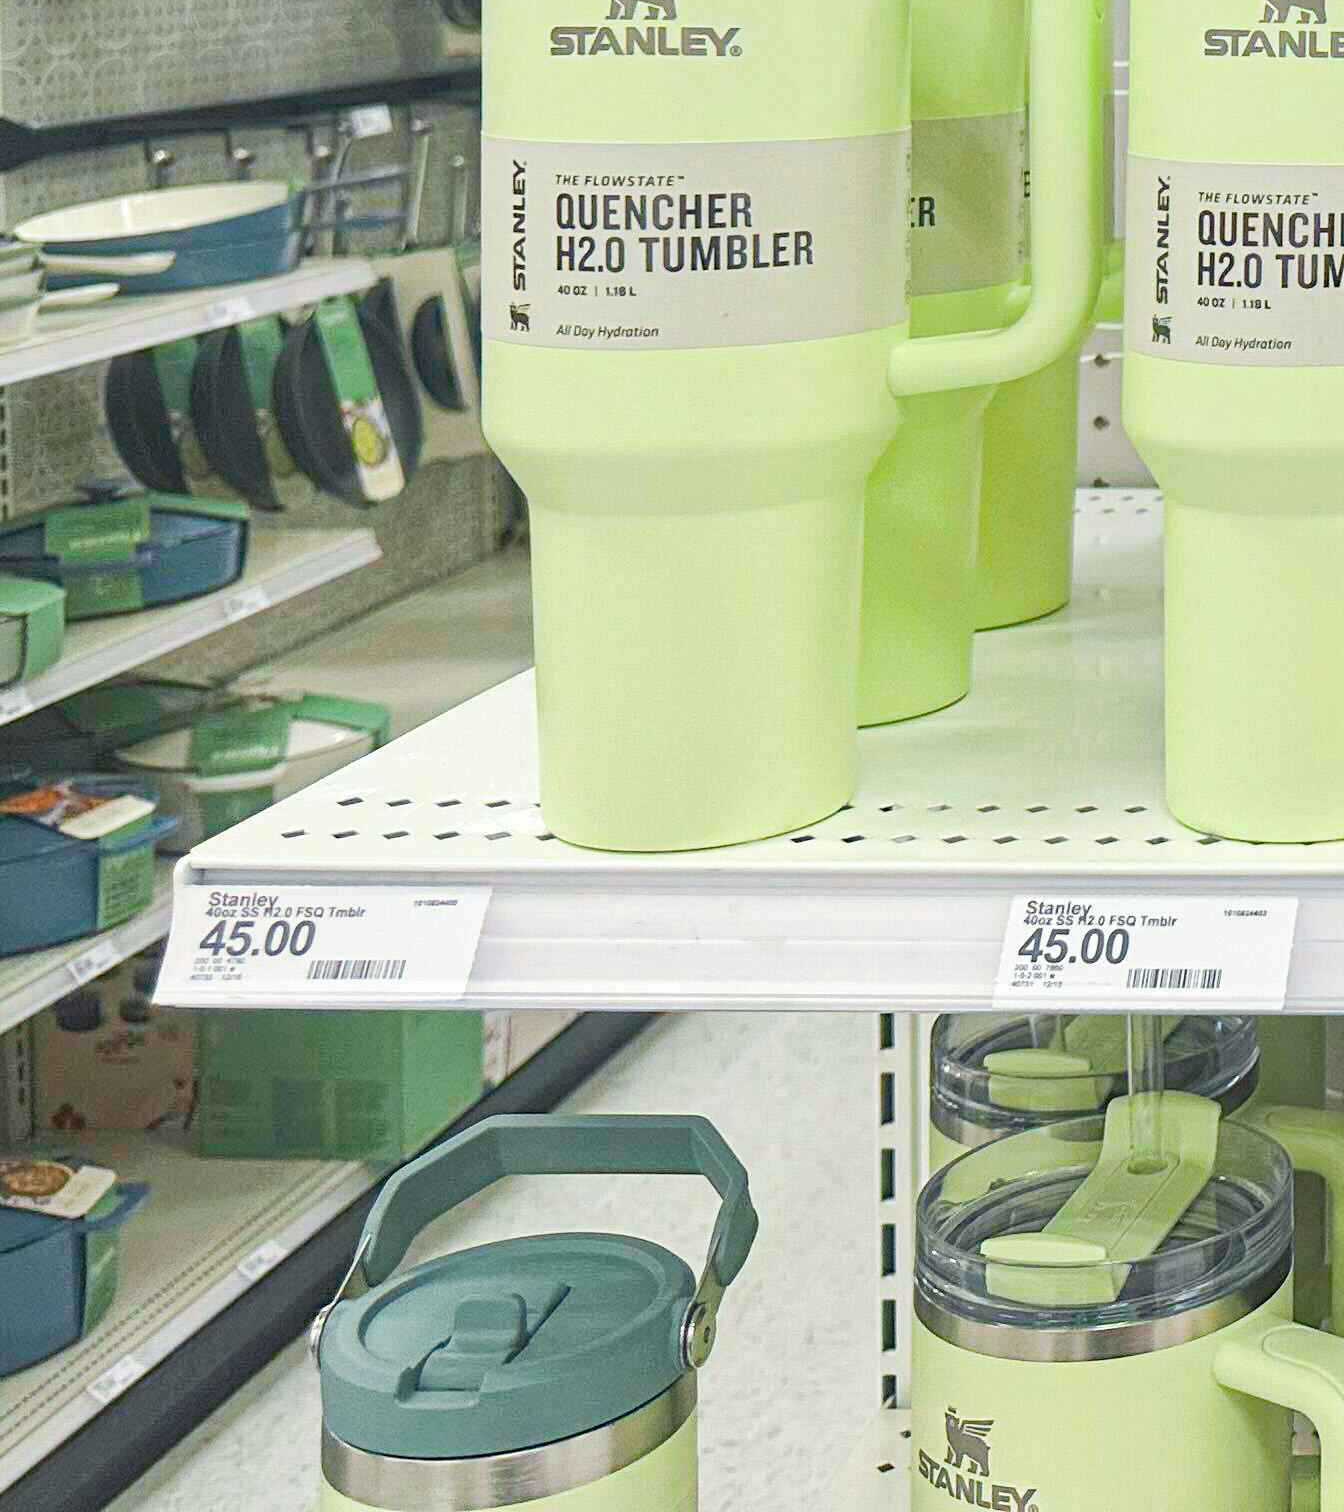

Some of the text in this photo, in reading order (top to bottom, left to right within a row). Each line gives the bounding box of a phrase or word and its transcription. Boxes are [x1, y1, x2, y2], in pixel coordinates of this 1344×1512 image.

[556, 174, 579, 186] THE
[1198, 192, 1221, 203] THE
[556, 193, 752, 231] QUENCHER
[513, 160, 528, 291] STANLEY
[1156, 175, 1170, 304] STANLEY
[556, 231, 814, 273] H2.0 TUMBLER
[1198, 252, 1263, 288] H2.0
[557, 285, 571, 295] 40
[573, 286, 587, 296] OZ
[629, 287, 637, 297] L
[1197, 297, 1210, 307] 40
[1212, 298, 1226, 308] OZ
[1264, 300, 1271, 310] L
[556, 325, 659, 339] All Day Hydration
[1195, 335, 1292, 351] All Day Hydration
[208, 892, 279, 910] Stanley
[1026, 900, 1092, 917] Stanley
[206, 907, 237, 918] 40oz
[241, 907, 260, 918] SS
[296, 907, 324, 918] FSQ
[328, 908, 366, 918] Tmblr
[1023, 915, 1052, 926] 40oz
[1057, 915, 1074, 926] SS
[1109, 915, 1137, 927] FSQ
[1141, 916, 1178, 927] Tmblr
[199, 920, 317, 957] 45.00
[1018, 928, 1130, 964] 45.00
